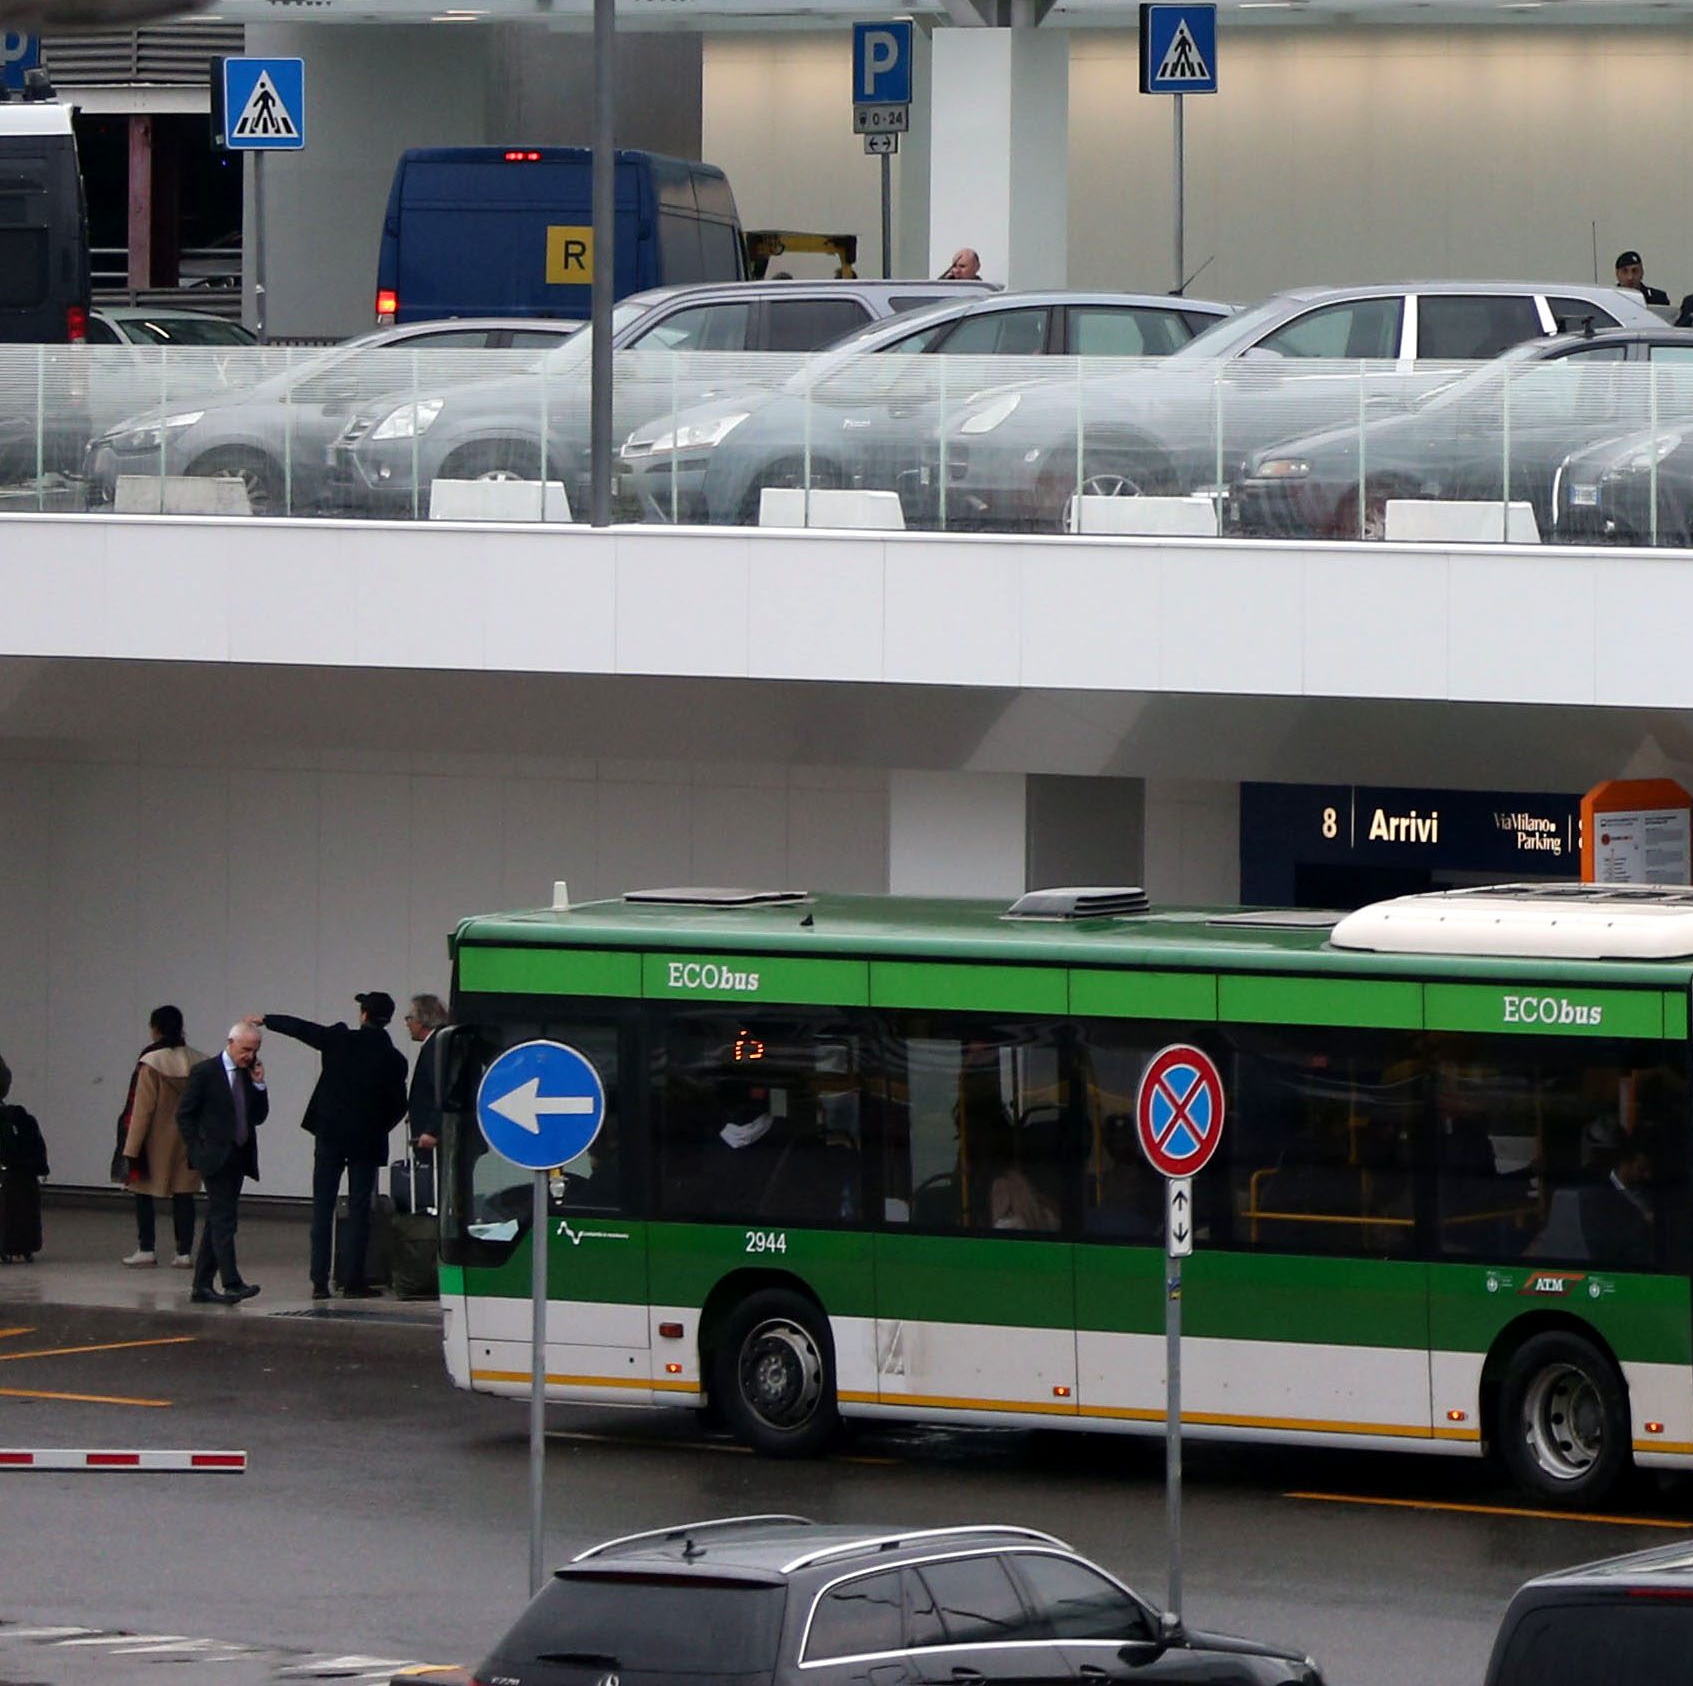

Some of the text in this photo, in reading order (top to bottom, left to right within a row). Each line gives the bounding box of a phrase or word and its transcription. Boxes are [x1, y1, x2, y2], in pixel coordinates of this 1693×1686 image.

[864, 31, 898, 95] P
[564, 240, 586, 270] R
[1322, 807, 1438, 843] 8 Arrivi
[1517, 832, 1561, 856] Parking
[668, 962, 760, 991] ECObus
[1503, 996, 1602, 1025] ECObus
[746, 1231, 787, 1254] 2944
[1535, 1277, 1564, 1292] ATM
